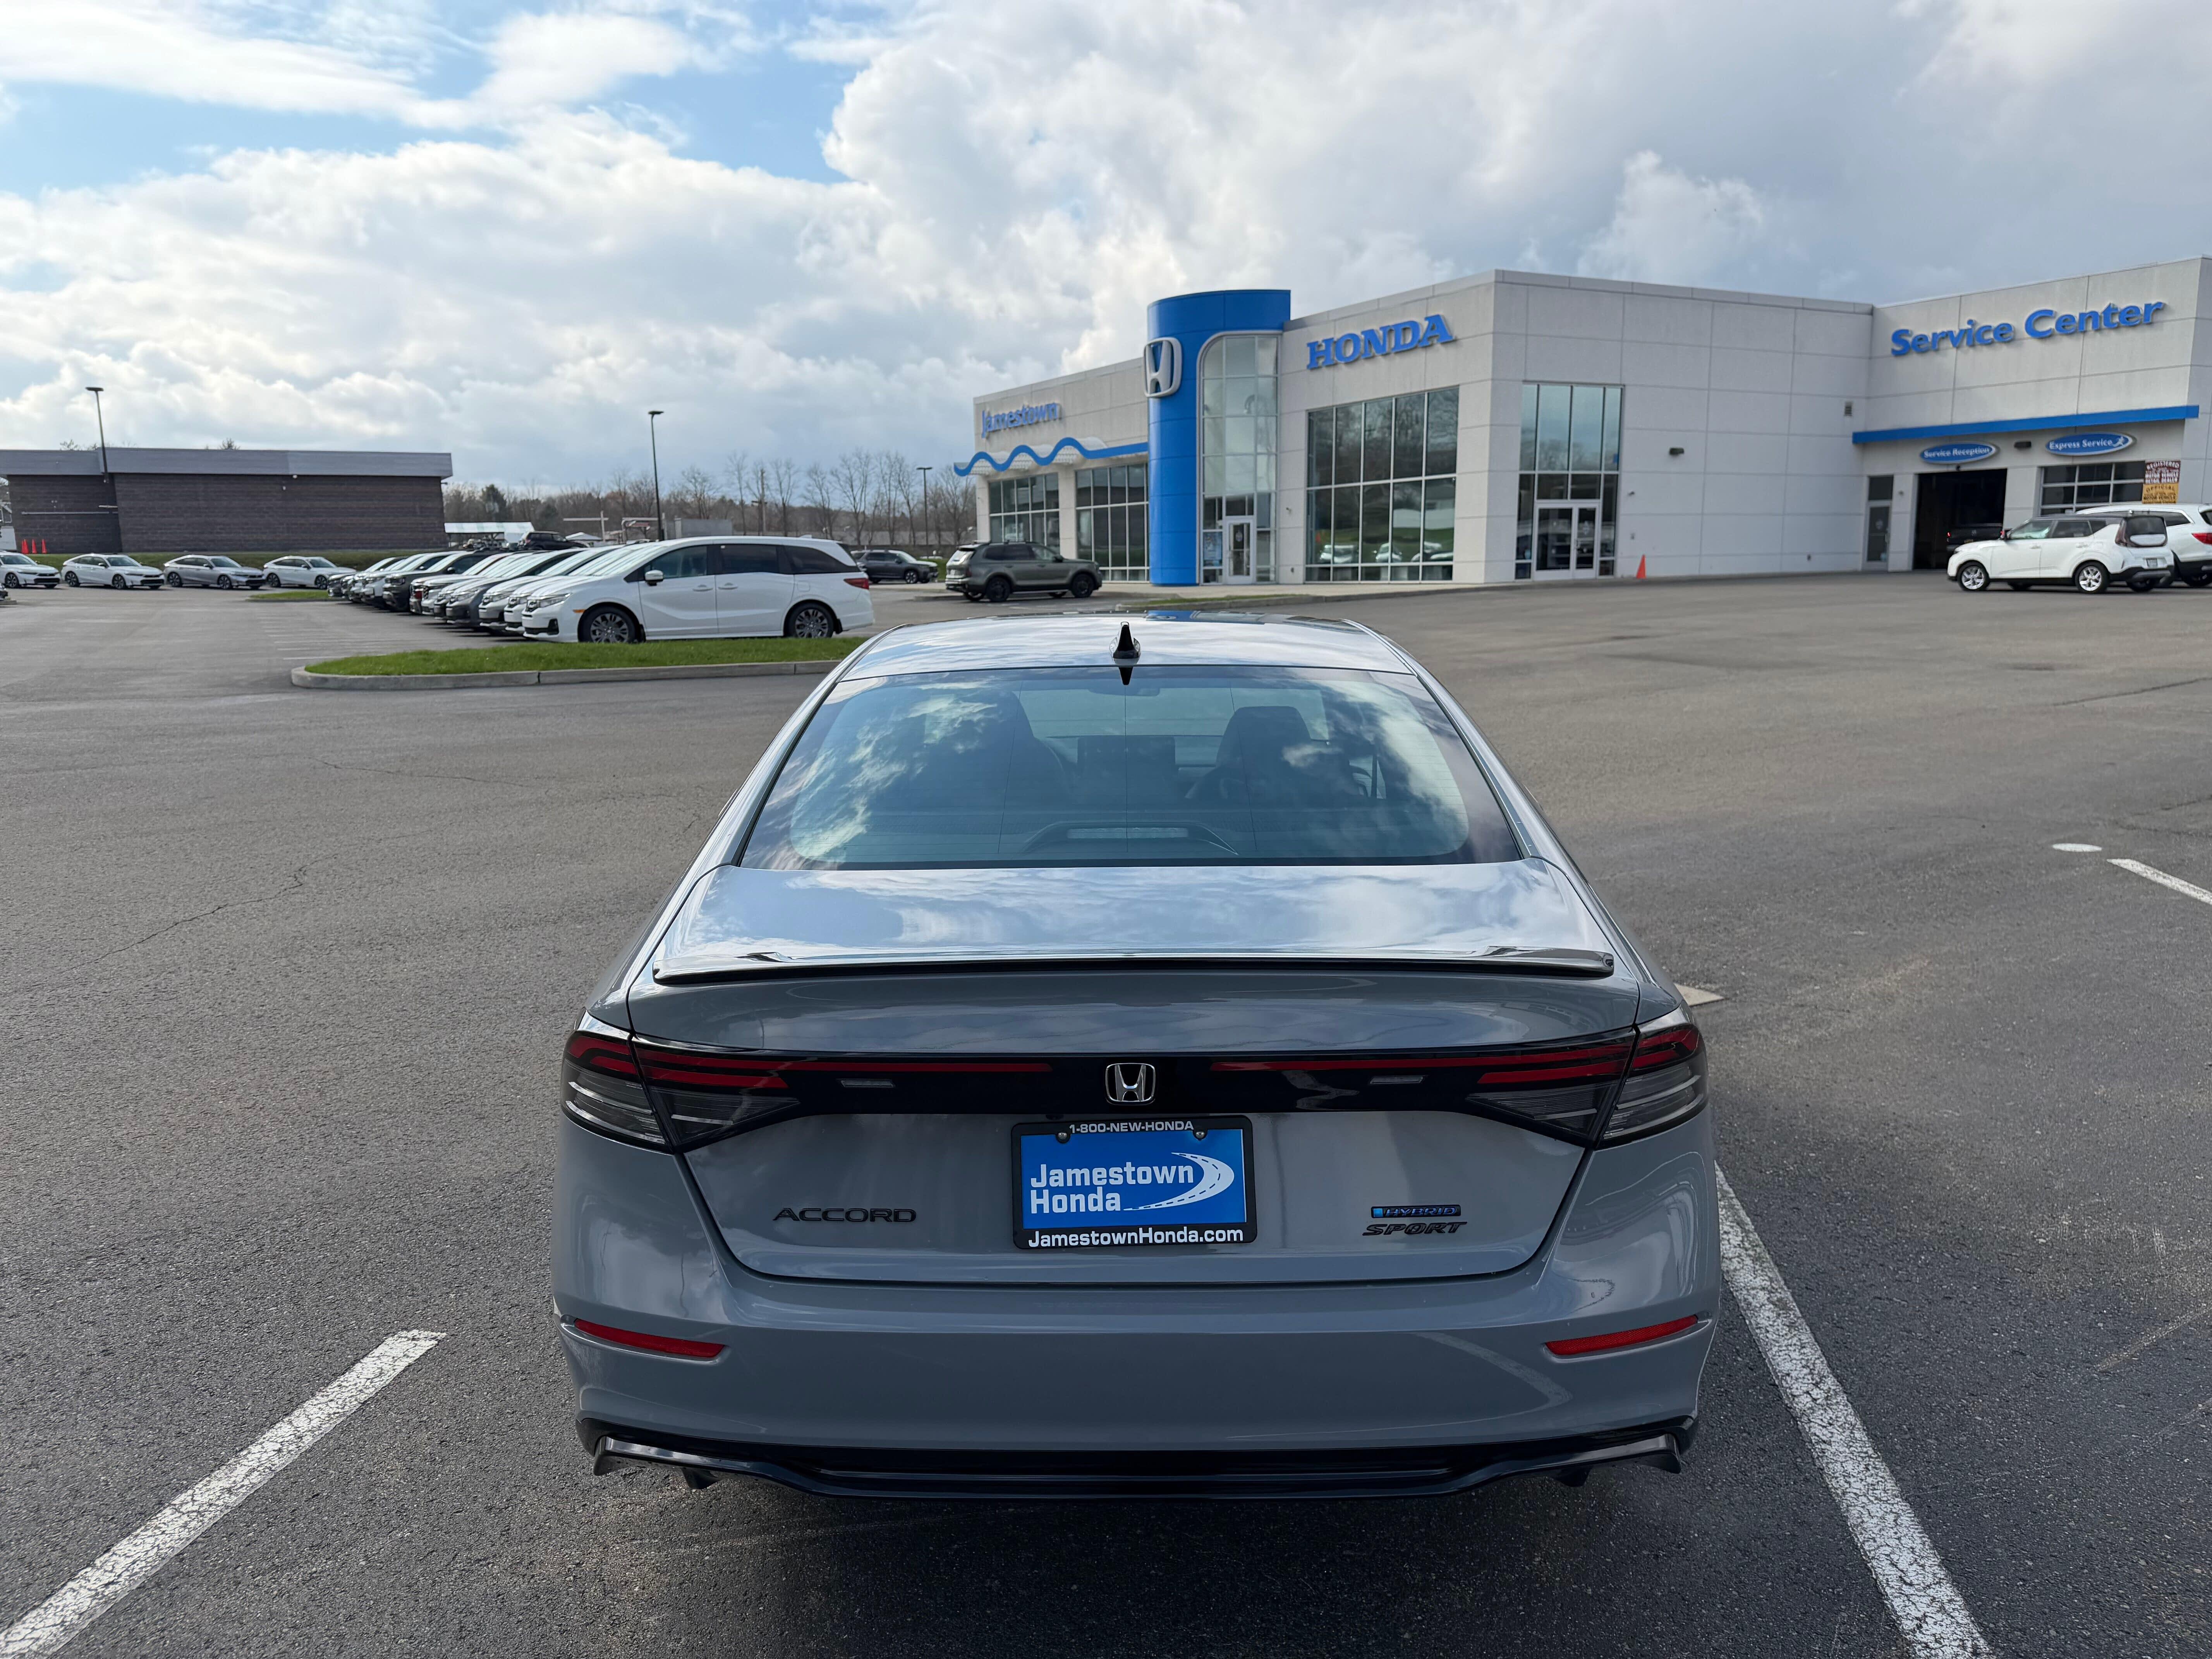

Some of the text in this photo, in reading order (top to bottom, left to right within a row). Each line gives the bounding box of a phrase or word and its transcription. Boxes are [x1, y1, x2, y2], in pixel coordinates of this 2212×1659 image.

[1891, 302, 2164, 356] Service Center
[1307, 314, 1453, 369] HONDA
[981, 402, 1059, 438] Jamestown
[1924, 447, 1989, 458] Service Reception
[2049, 438, 2112, 451] Express Service
[1069, 1121, 1194, 1134] 1-800-NEW-HONDA
[1030, 1162, 1194, 1188] Jamestown
[1030, 1187, 1121, 1214] Honda
[773, 1207, 917, 1223] ACCORD
[1386, 1207, 1456, 1217] HYBRID
[1028, 1226, 1243, 1247] JamestownHonda.com
[1362, 1221, 1467, 1236] SPORT
